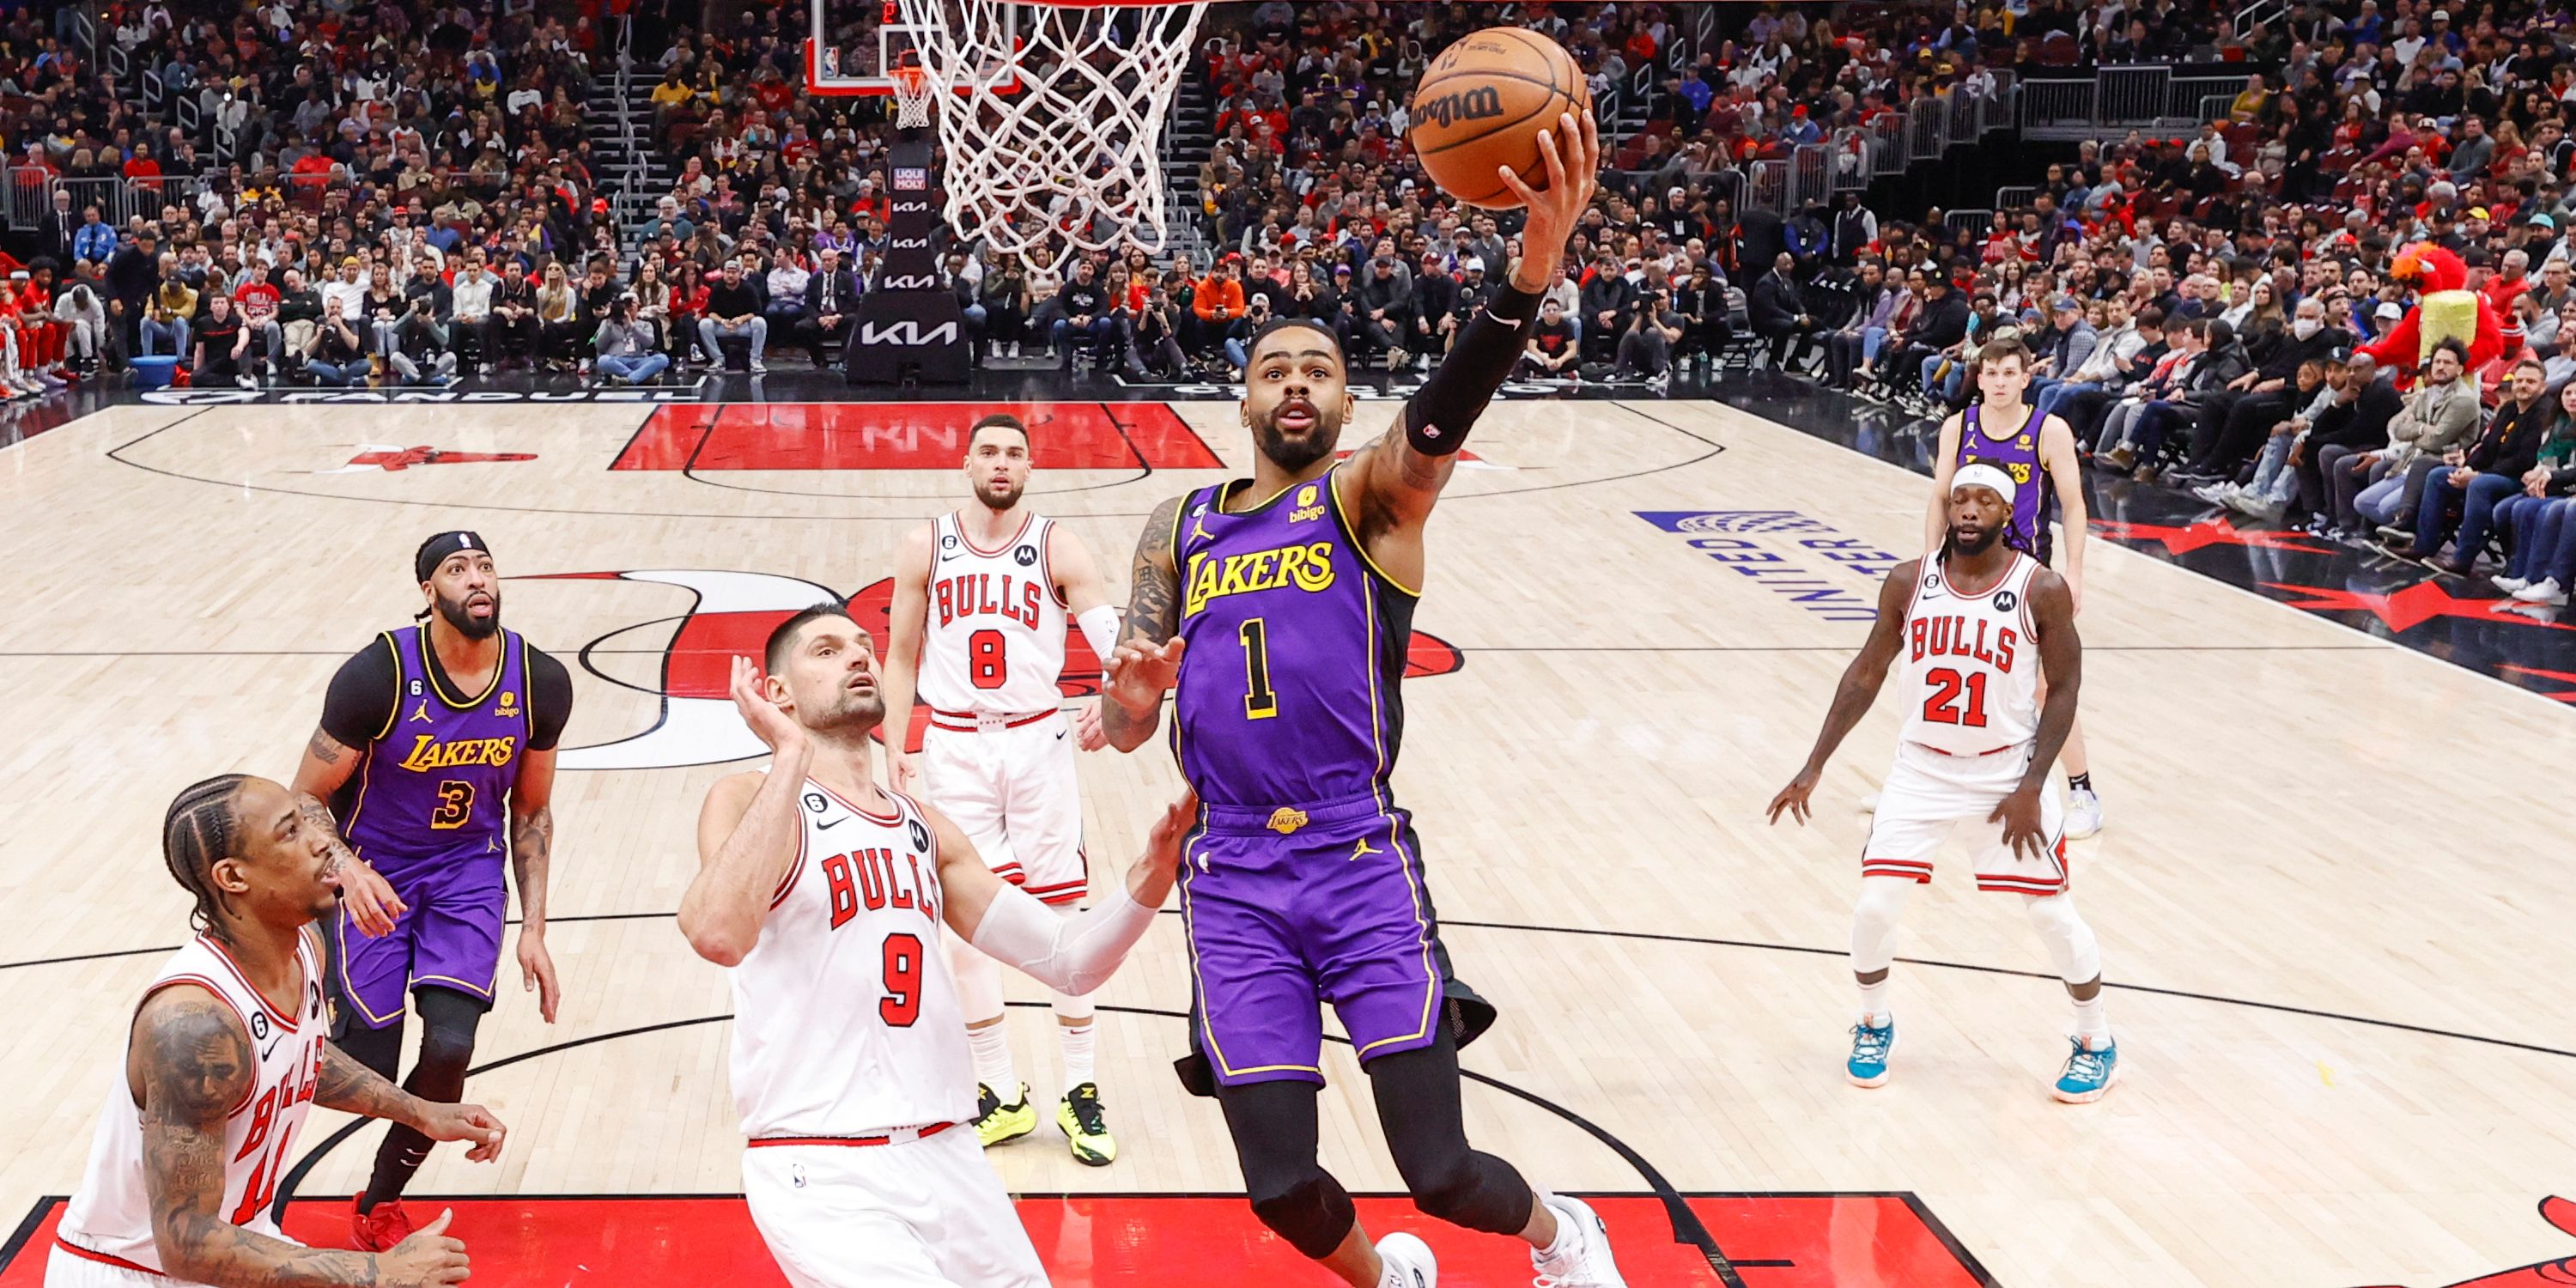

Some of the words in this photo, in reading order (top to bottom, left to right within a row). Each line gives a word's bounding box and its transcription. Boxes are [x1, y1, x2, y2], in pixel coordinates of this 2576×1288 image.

[895, 179, 926, 190] MOLY
[861, 320, 957, 345] KIA
[279, 392, 702, 402] FANDUEL
[1289, 506, 1325, 524] bibigo
[935, 574, 1042, 631] BULLS
[1184, 542, 1335, 619] LAKERS
[969, 629, 1007, 690] 8
[1239, 617, 1278, 720] 1
[1911, 615, 2017, 674] BULLS
[410, 680, 422, 696] 6
[495, 707, 519, 718] bibigo
[1923, 667, 1987, 728] 21
[398, 735, 516, 772] LAKERS
[430, 780, 476, 829] 3
[879, 933, 923, 1027] 9
